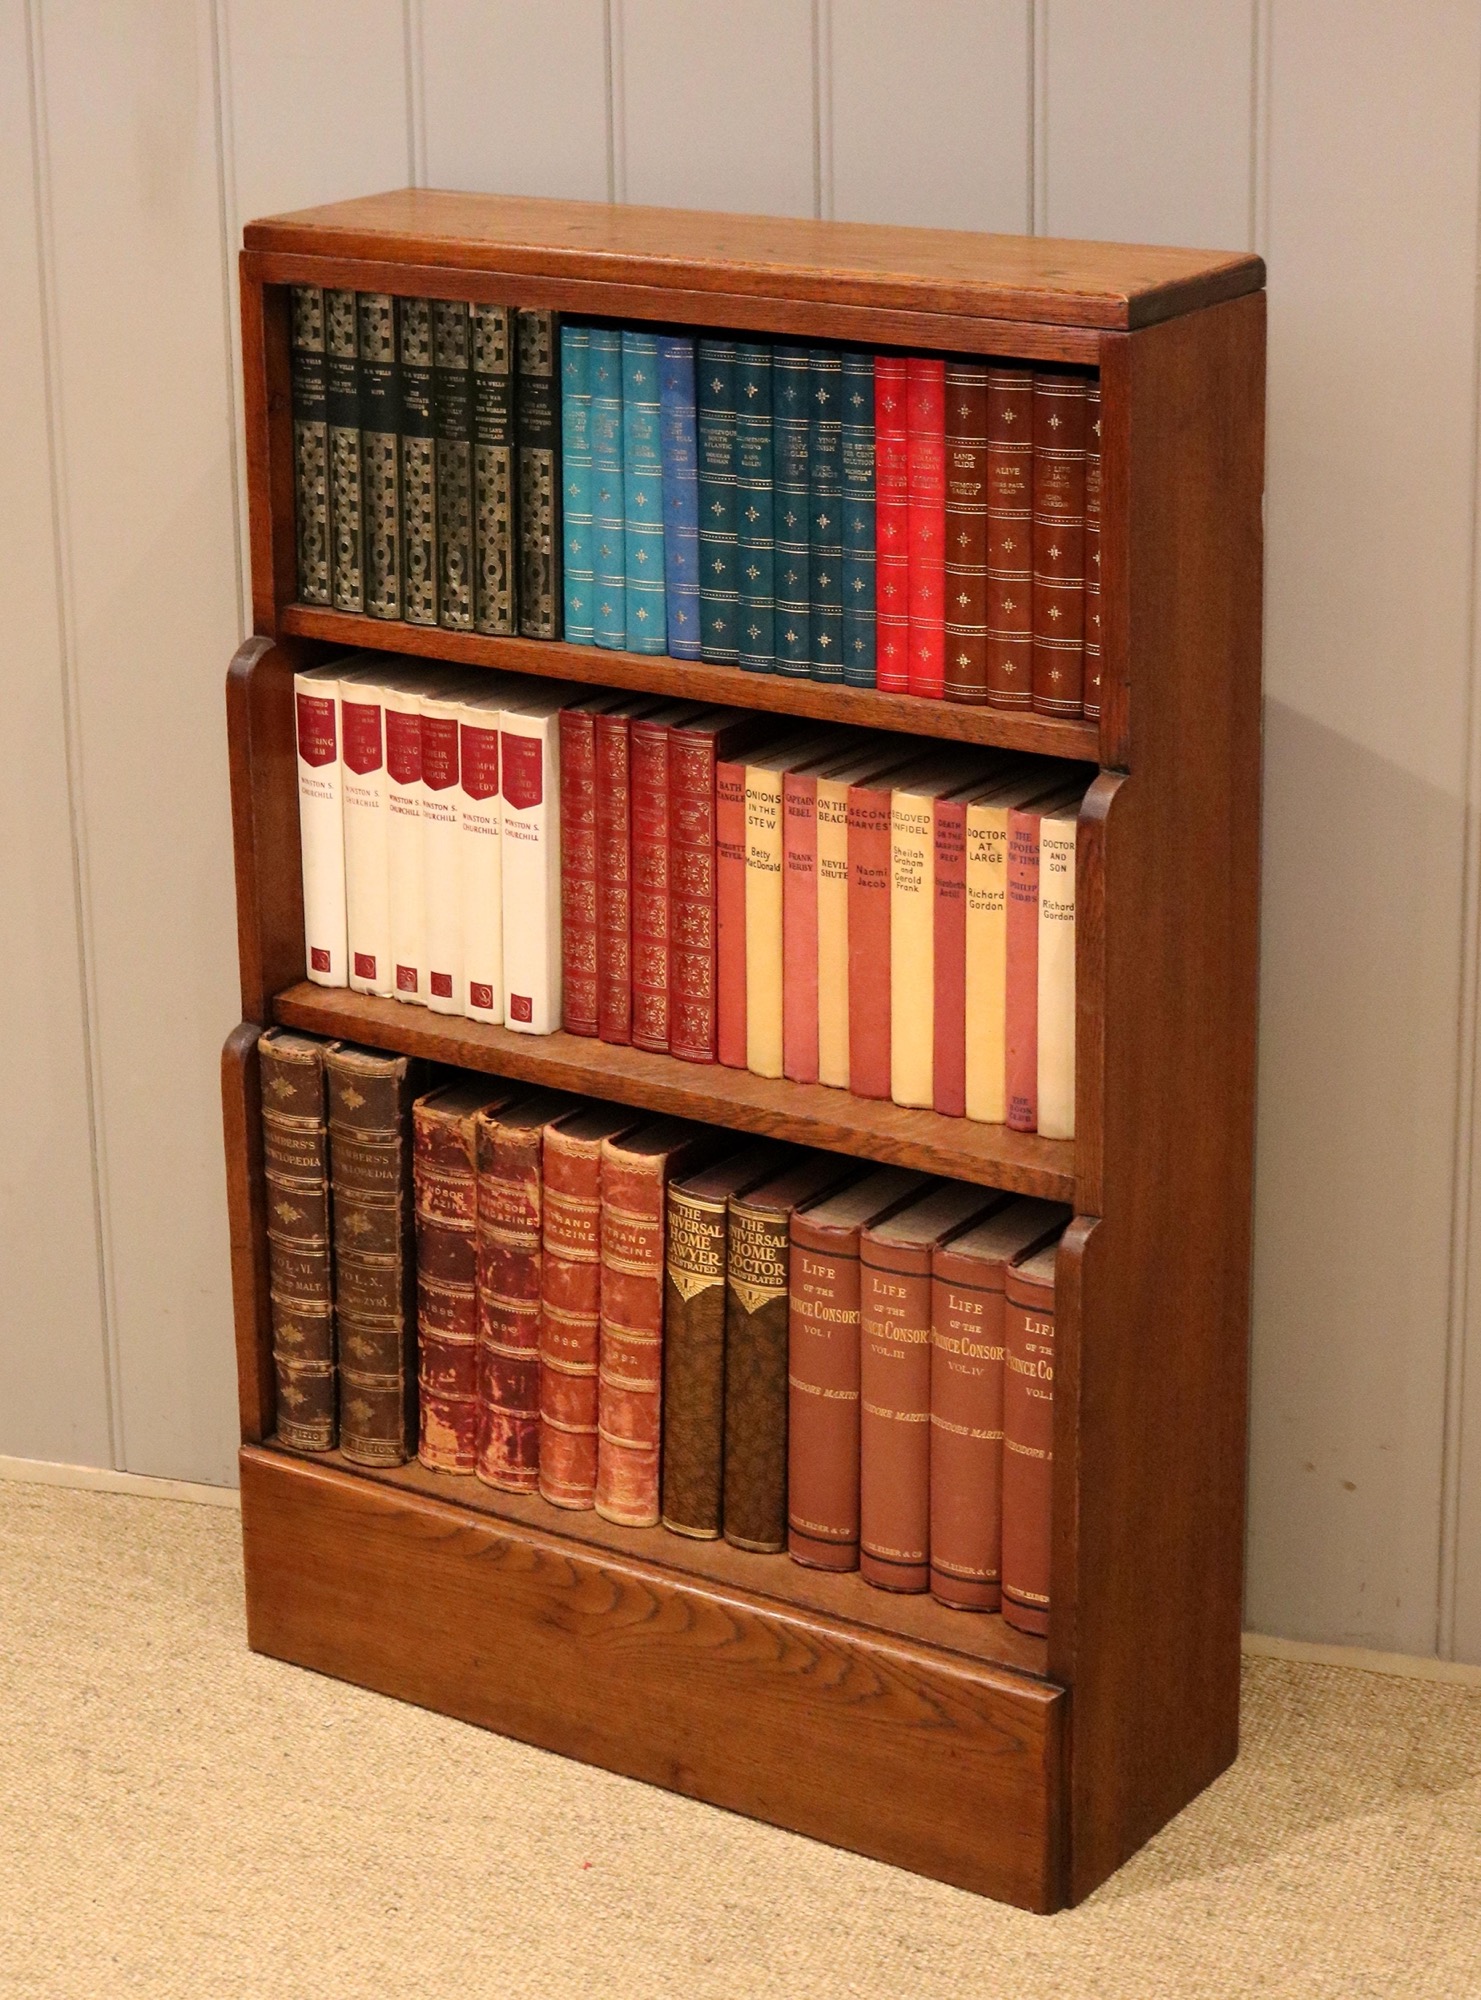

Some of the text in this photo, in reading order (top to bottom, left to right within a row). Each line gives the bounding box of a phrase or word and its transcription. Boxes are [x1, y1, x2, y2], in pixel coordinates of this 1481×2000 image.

[954, 461, 976, 469] SLIDE
[995, 467, 1021, 475] ALIVE
[301, 777, 326, 789] WINSTON
[719, 780, 742, 791] BATH
[301, 787, 334, 800] CHURCHILL
[346, 786, 372, 797] WINSTON
[745, 789, 781, 804] ONIONS
[346, 796, 380, 808] CHURCHILL
[389, 794, 421, 806] WINSTON S.
[423, 799, 448, 811] WINSTON
[785, 793, 814, 806] CAPTAIN
[817, 799, 831, 810] ON
[390, 804, 421, 817] CHURCHILL
[423, 810, 457, 822] CHURCHILL
[759, 805, 776, 816] THE
[788, 805, 812, 818] REBEL
[892, 809, 931, 824] BELOVED
[463, 813, 499, 825] WINSTON S.
[505, 817, 531, 830] WINSTON
[748, 816, 777, 830] STEW
[938, 819, 962, 830] DEATH
[463, 823, 499, 836] CHURCHILL
[893, 821, 929, 835] INFIDEL
[968, 828, 1007, 841] DOCTOR
[505, 828, 539, 842] CHURCHILL
[1015, 831, 1032, 841] THE
[978, 842, 993, 851] AT
[1010, 842, 1040, 854] SPOILS
[1043, 839, 1075, 851] DOCTOR
[751, 846, 771, 862] Betty
[788, 851, 813, 862] FRANK
[894, 846, 924, 859] Sheilah
[969, 851, 1003, 863] LARGE
[1050, 851, 1067, 862] AND
[745, 858, 781, 872] MacDonald
[822, 860, 848, 870] NEVIL
[894, 855, 924, 868] Graham
[1049, 863, 1067, 873] SON
[820, 869, 848, 880] SHUTE
[857, 865, 888, 877] Naomi
[901, 866, 913, 875] and
[857, 877, 887, 889] Jacob
[894, 873, 922, 885] Gerold
[896, 881, 920, 893] Frank
[1009, 880, 1038, 892] PHILIP
[968, 887, 1005, 900] Richard
[969, 900, 1004, 912] Gordon
[1043, 899, 1075, 911] Richard
[1044, 910, 1075, 922] Gordon
[268, 1133, 316, 1150] AMBERS'S
[426, 1184, 465, 1201] NDSOR
[428, 1198, 468, 1212] AZINE
[482, 1206, 534, 1227] GAZINE
[677, 1204, 702, 1222] THE
[548, 1211, 592, 1230] TRAND
[668, 1210, 725, 1238] NIVERSAL
[741, 1217, 765, 1234] THE
[547, 1223, 602, 1243] GAZINE.
[603, 1225, 647, 1246] TRAND
[671, 1226, 712, 1251] HOME
[729, 1224, 789, 1249] NIVERSAL
[605, 1239, 656, 1259] GAZINE.
[670, 1242, 724, 1266] AWYER
[732, 1241, 776, 1262] HOME
[300, 1264, 313, 1274] VI.
[728, 1252, 788, 1278] DOCTOR
[802, 1258, 836, 1280] LIFE
[295, 1281, 323, 1292] MALT.
[371, 1276, 384, 1288] X.
[803, 1284, 835, 1299] OF THE
[872, 1278, 908, 1303] LIFE
[873, 1303, 907, 1319] OF THE
[949, 1294, 984, 1316] LIFE
[804, 1325, 833, 1340] VOL. I
[949, 1319, 983, 1334] OF THE
[1025, 1343, 1038, 1353] OF
[823, 1389, 859, 1401] MARTIN
